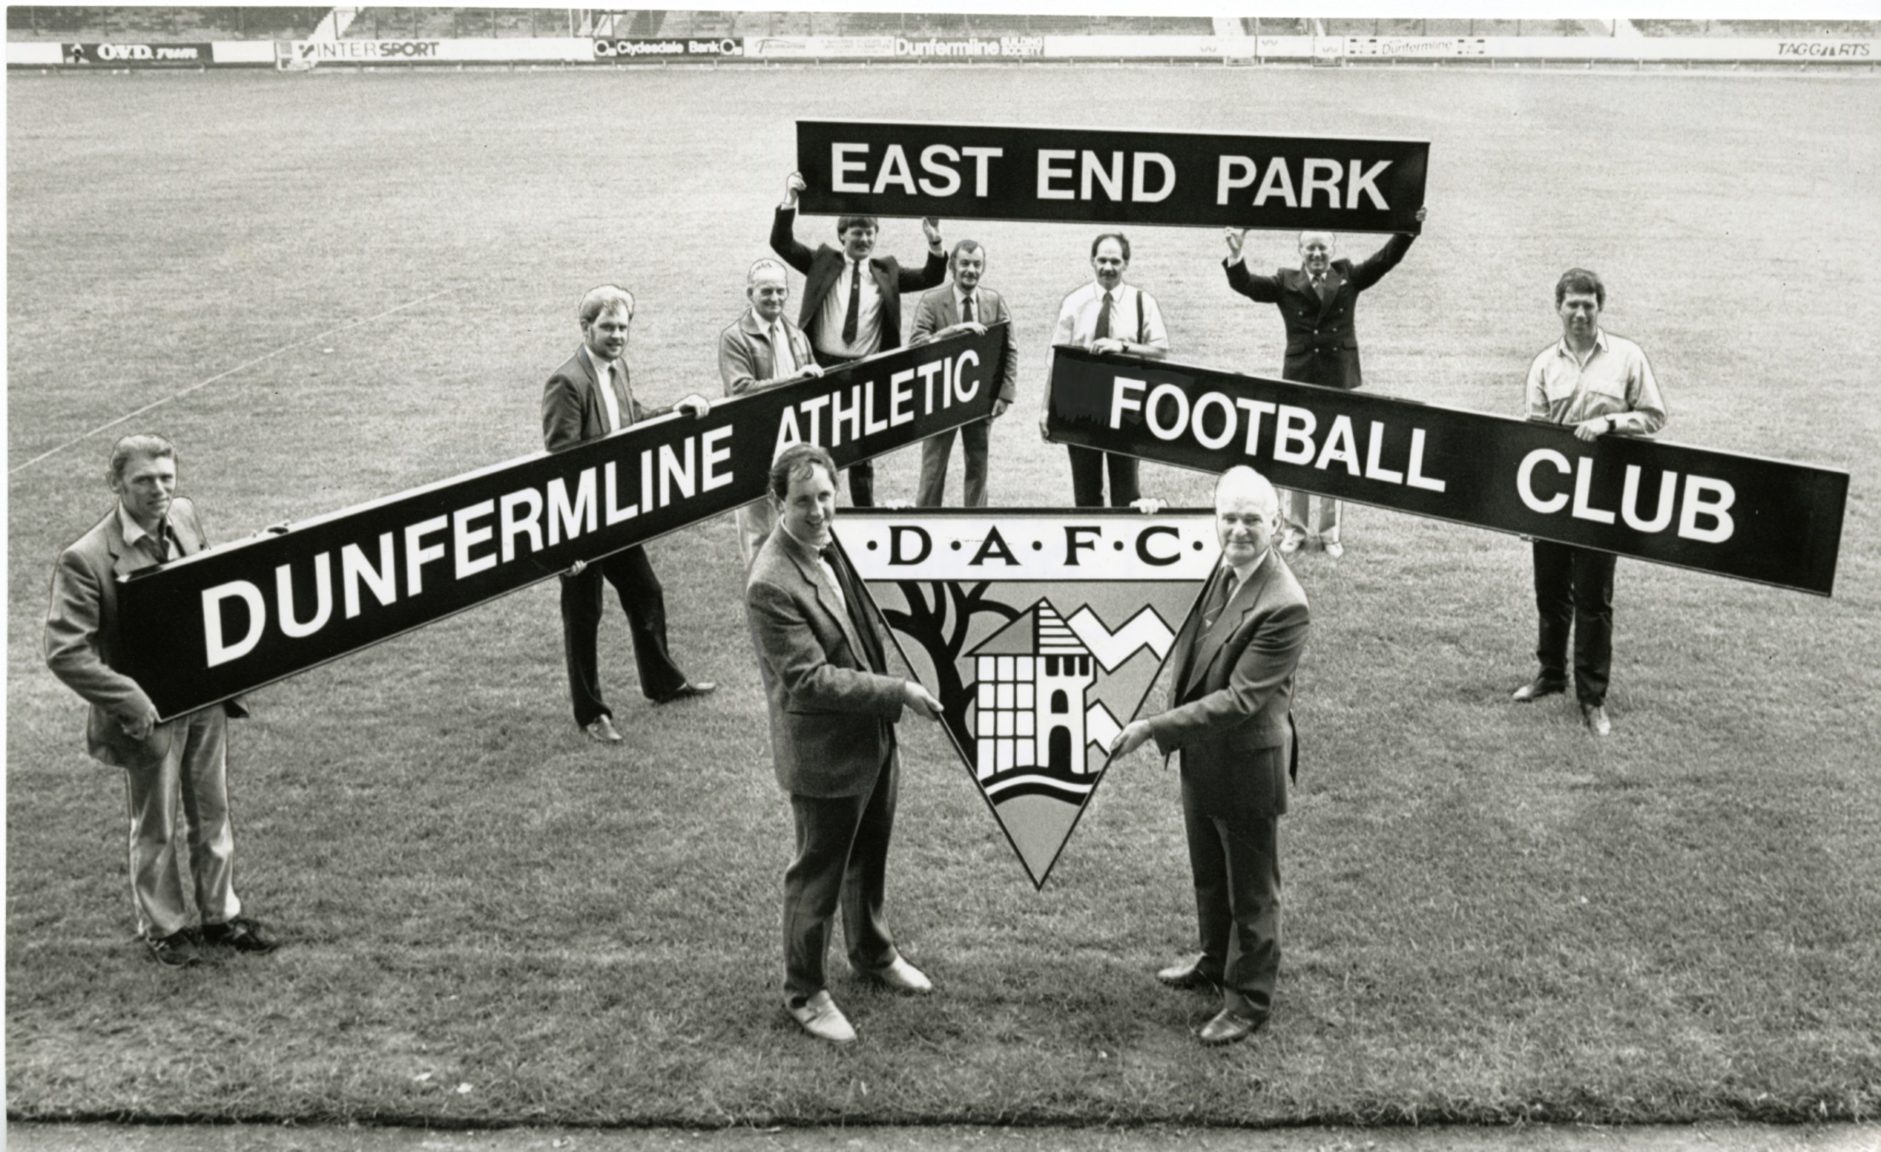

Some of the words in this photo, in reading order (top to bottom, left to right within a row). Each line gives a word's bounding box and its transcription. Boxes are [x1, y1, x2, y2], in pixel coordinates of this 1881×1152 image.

[317, 42, 439, 57] INTERSPORT
[617, 40, 684, 56] Clydesdale
[688, 40, 720, 53] Bank
[895, 38, 999, 56] Dunfermline
[831, 142, 1003, 197] EAST
[1037, 149, 1176, 203] END
[1217, 155, 1392, 210] PARK
[1109, 376, 1446, 493] FOOTBALL
[1516, 448, 1736, 543] CLUB
[201, 424, 734, 668] DUNFERMLINE
[771, 349, 980, 468] ATHLETIC
